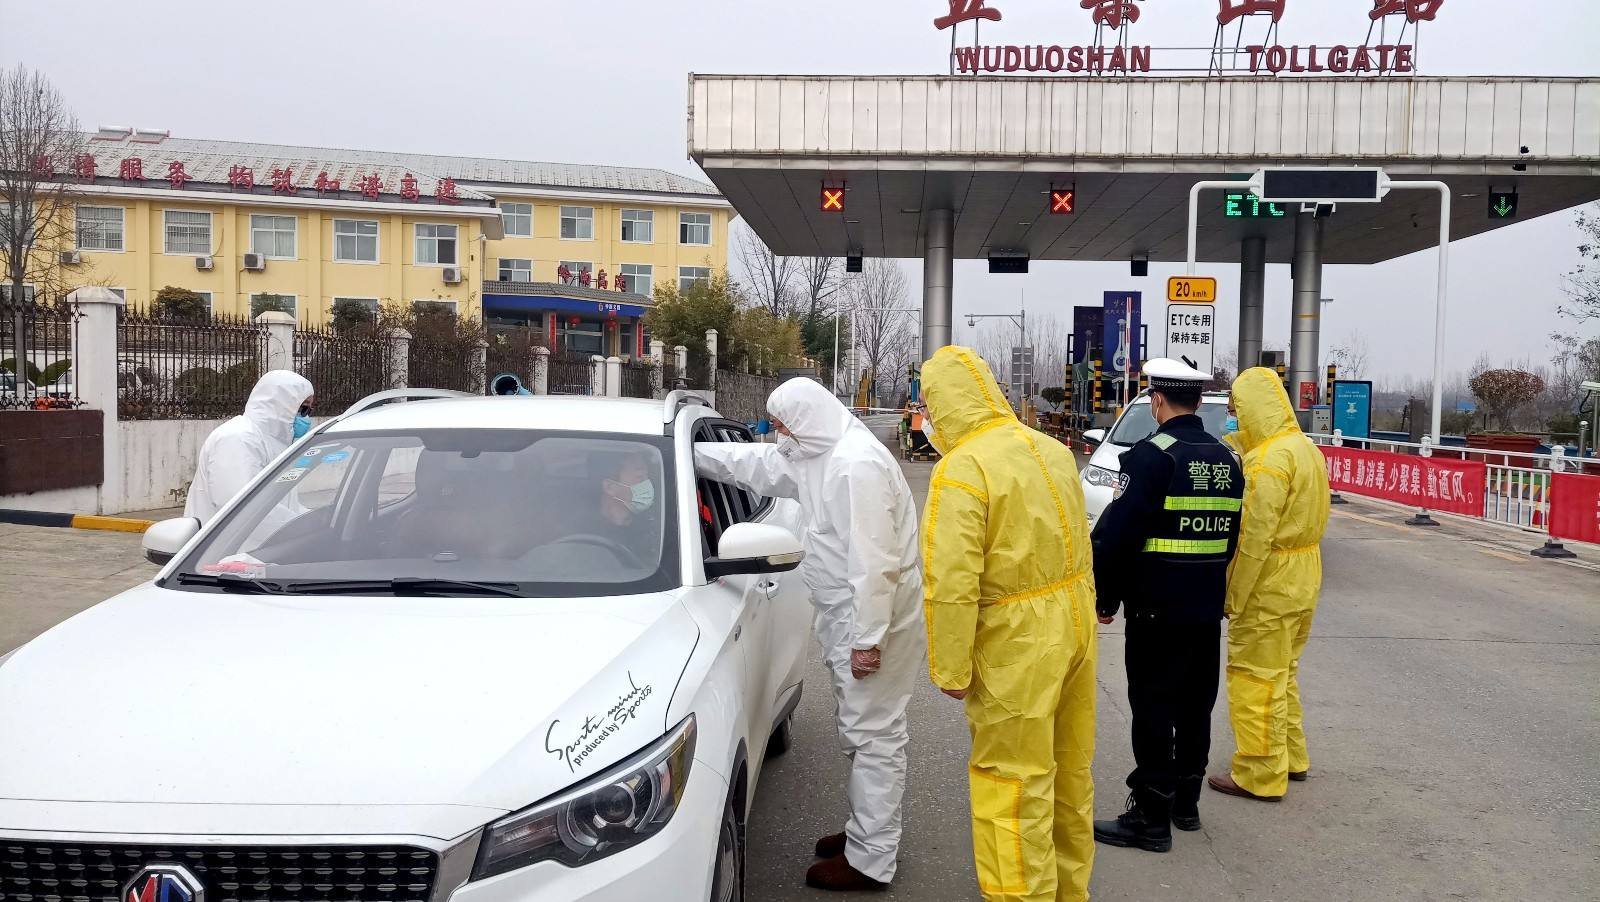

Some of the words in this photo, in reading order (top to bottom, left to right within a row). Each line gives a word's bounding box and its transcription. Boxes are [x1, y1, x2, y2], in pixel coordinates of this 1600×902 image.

[955, 45, 1151, 73] WUDUOSHAN
[1246, 44, 1413, 73] TOLLGATE
[1226, 194, 1285, 216] ETC
[1175, 281, 1190, 297] 20
[1192, 290, 1207, 298] km/h
[1170, 313, 1211, 327] ETC专用
[1170, 331, 1211, 345] 保持车距
[1188, 461, 1233, 491] 警察
[1179, 516, 1232, 532] POLICE
[614, 684, 652, 725] Sports
[609, 722, 620, 731] by
[573, 727, 610, 767] produced
